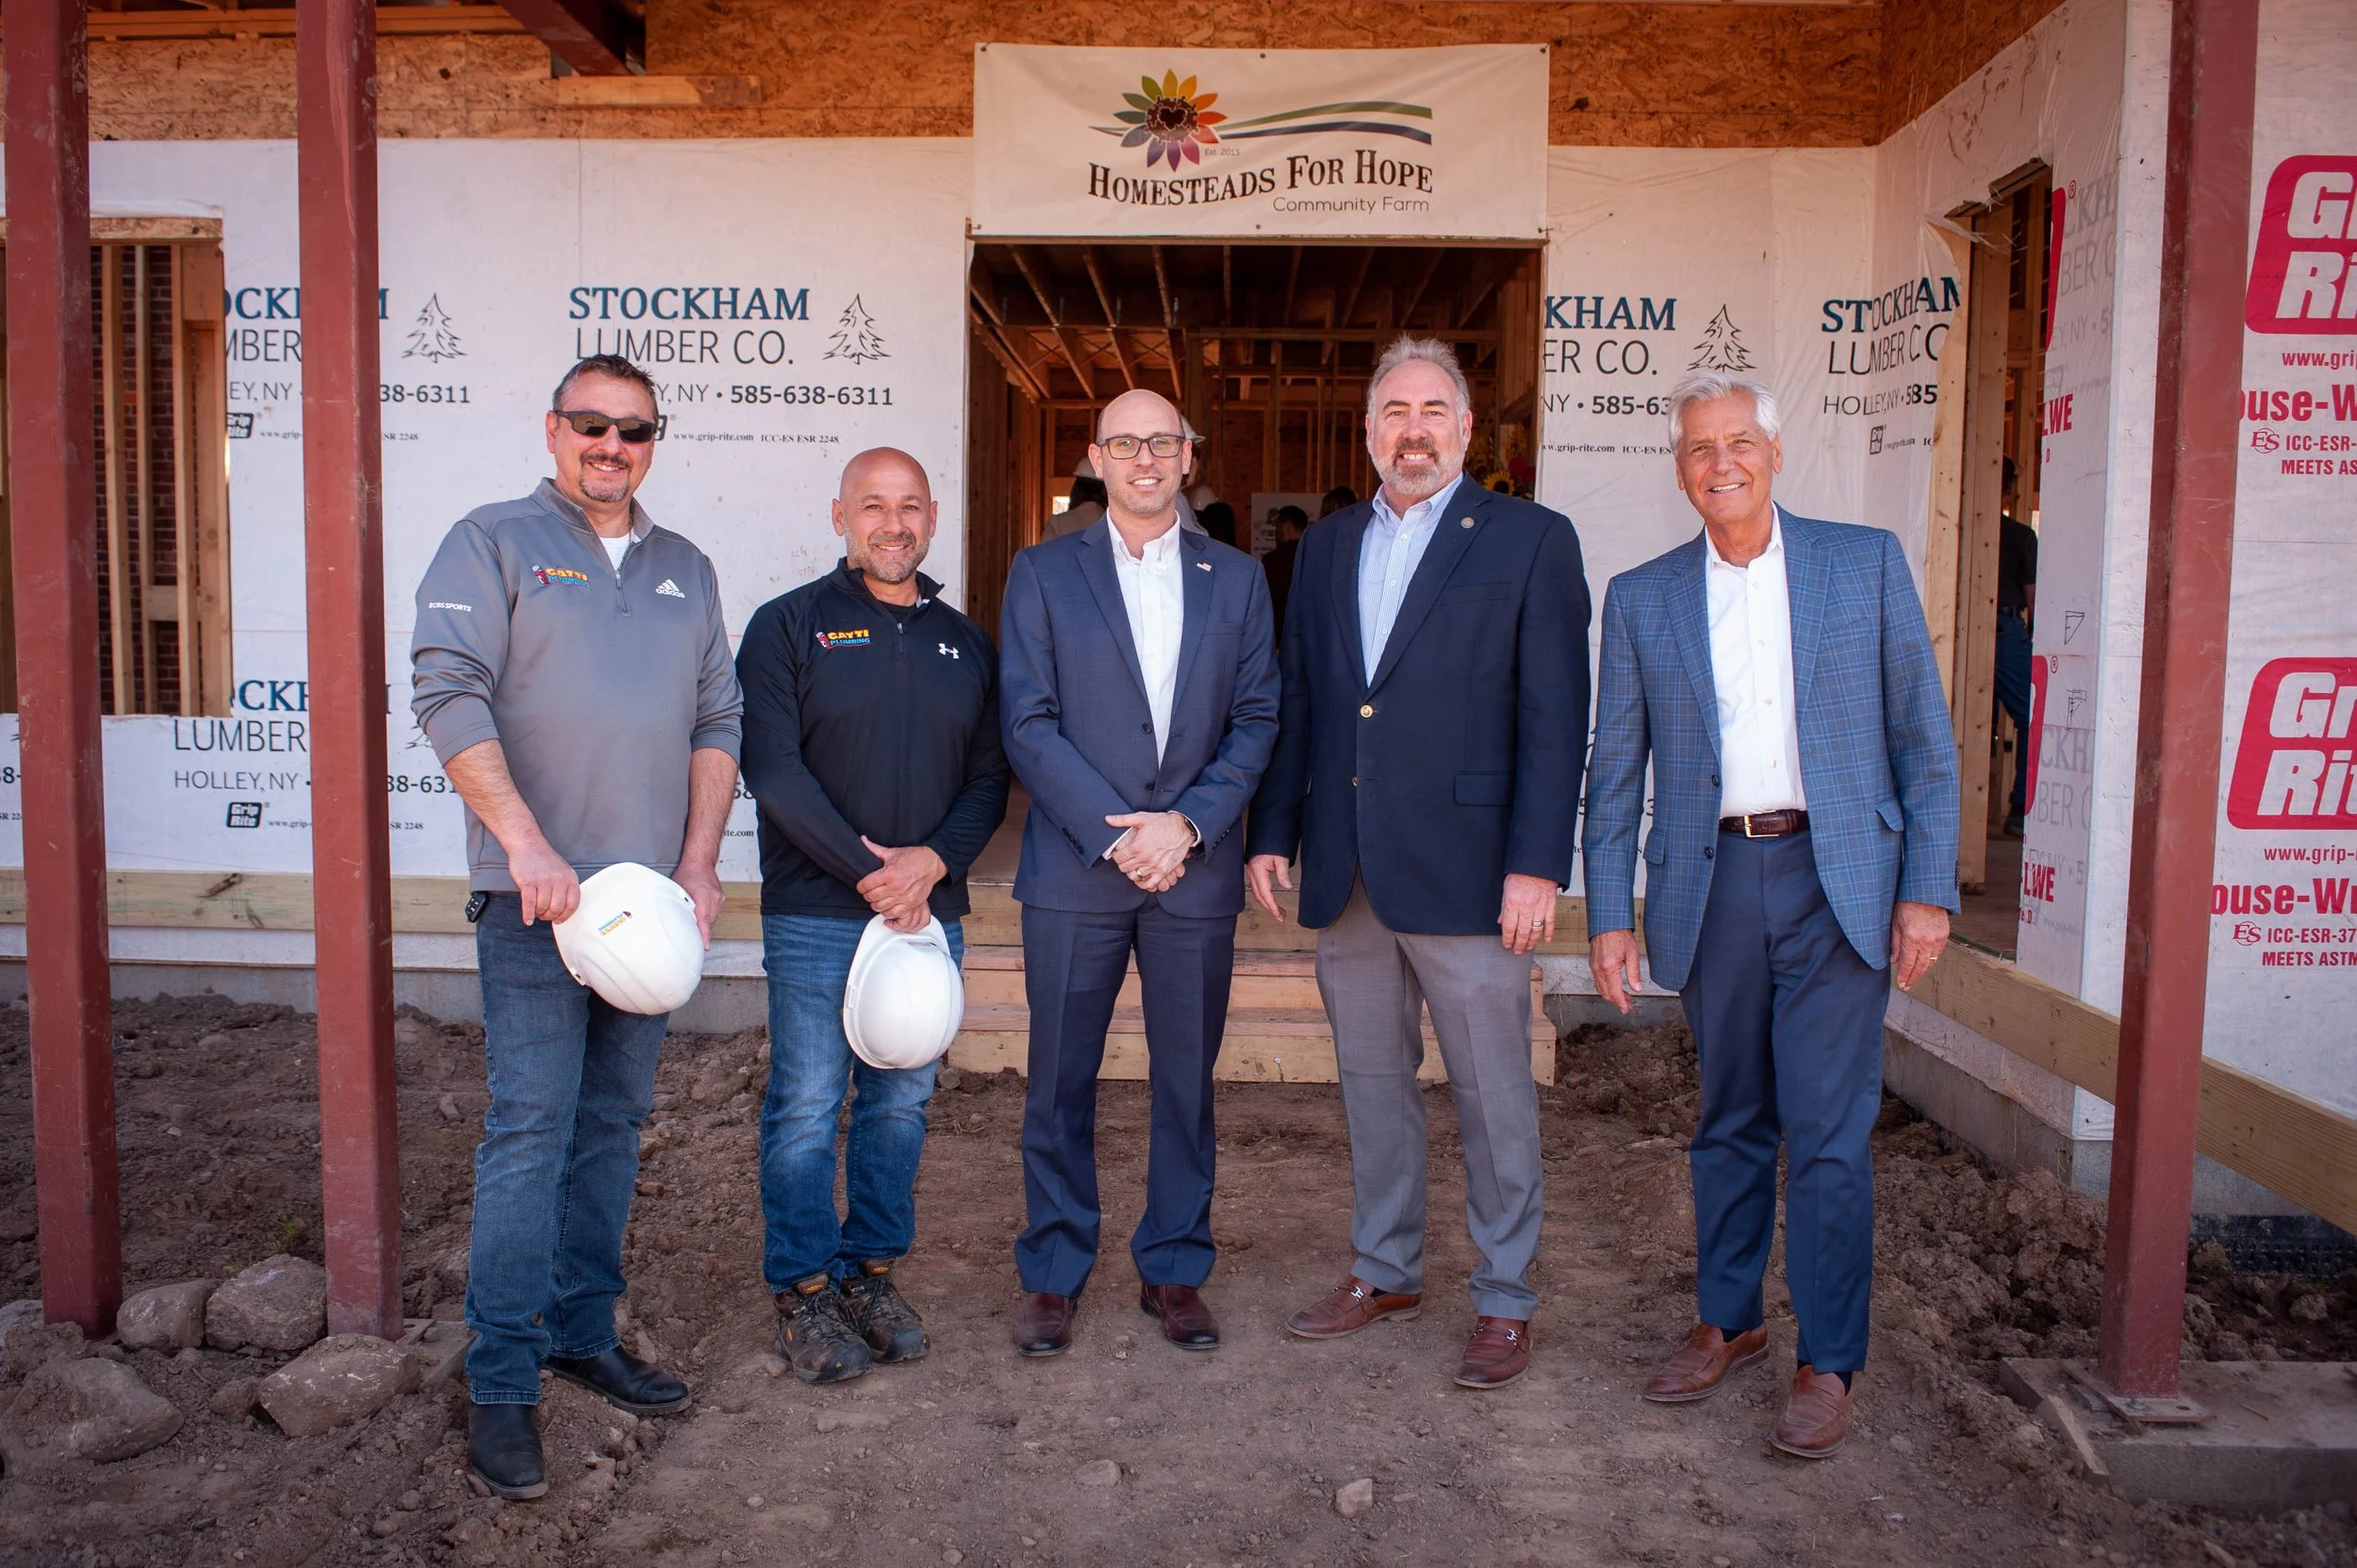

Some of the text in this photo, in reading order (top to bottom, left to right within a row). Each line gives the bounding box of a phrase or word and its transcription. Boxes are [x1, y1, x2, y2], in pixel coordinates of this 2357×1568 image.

[1088, 149, 1433, 206] HOMESTEADS FOR HOPE
[1273, 196, 1429, 214] Community Farm
[569, 287, 810, 322] STOCKHAM
[576, 327, 794, 365] LUMBER CO.
[1828, 330, 1905, 375] LUMBER
[1596, 339, 1657, 375] CO.
[2282, 350, 2357, 371] www.gri
[263, 382, 293, 401] NY
[678, 384, 709, 403] NY
[731, 385, 893, 405] 585-638-6311
[673, 433, 754, 442] www.grip-rite.com
[761, 435, 794, 443] ICC-ES
[819, 436, 839, 444] 2248
[1623, 446, 1656, 454] ICC-ES
[2282, 459, 2333, 475] MEETS
[830, 637, 871, 646] PLUMBING
[174, 719, 307, 753] LUMBER
[174, 769, 264, 792] HOLLEY,
[270, 772, 298, 790] NY
[2263, 951, 2314, 966] MEETS
